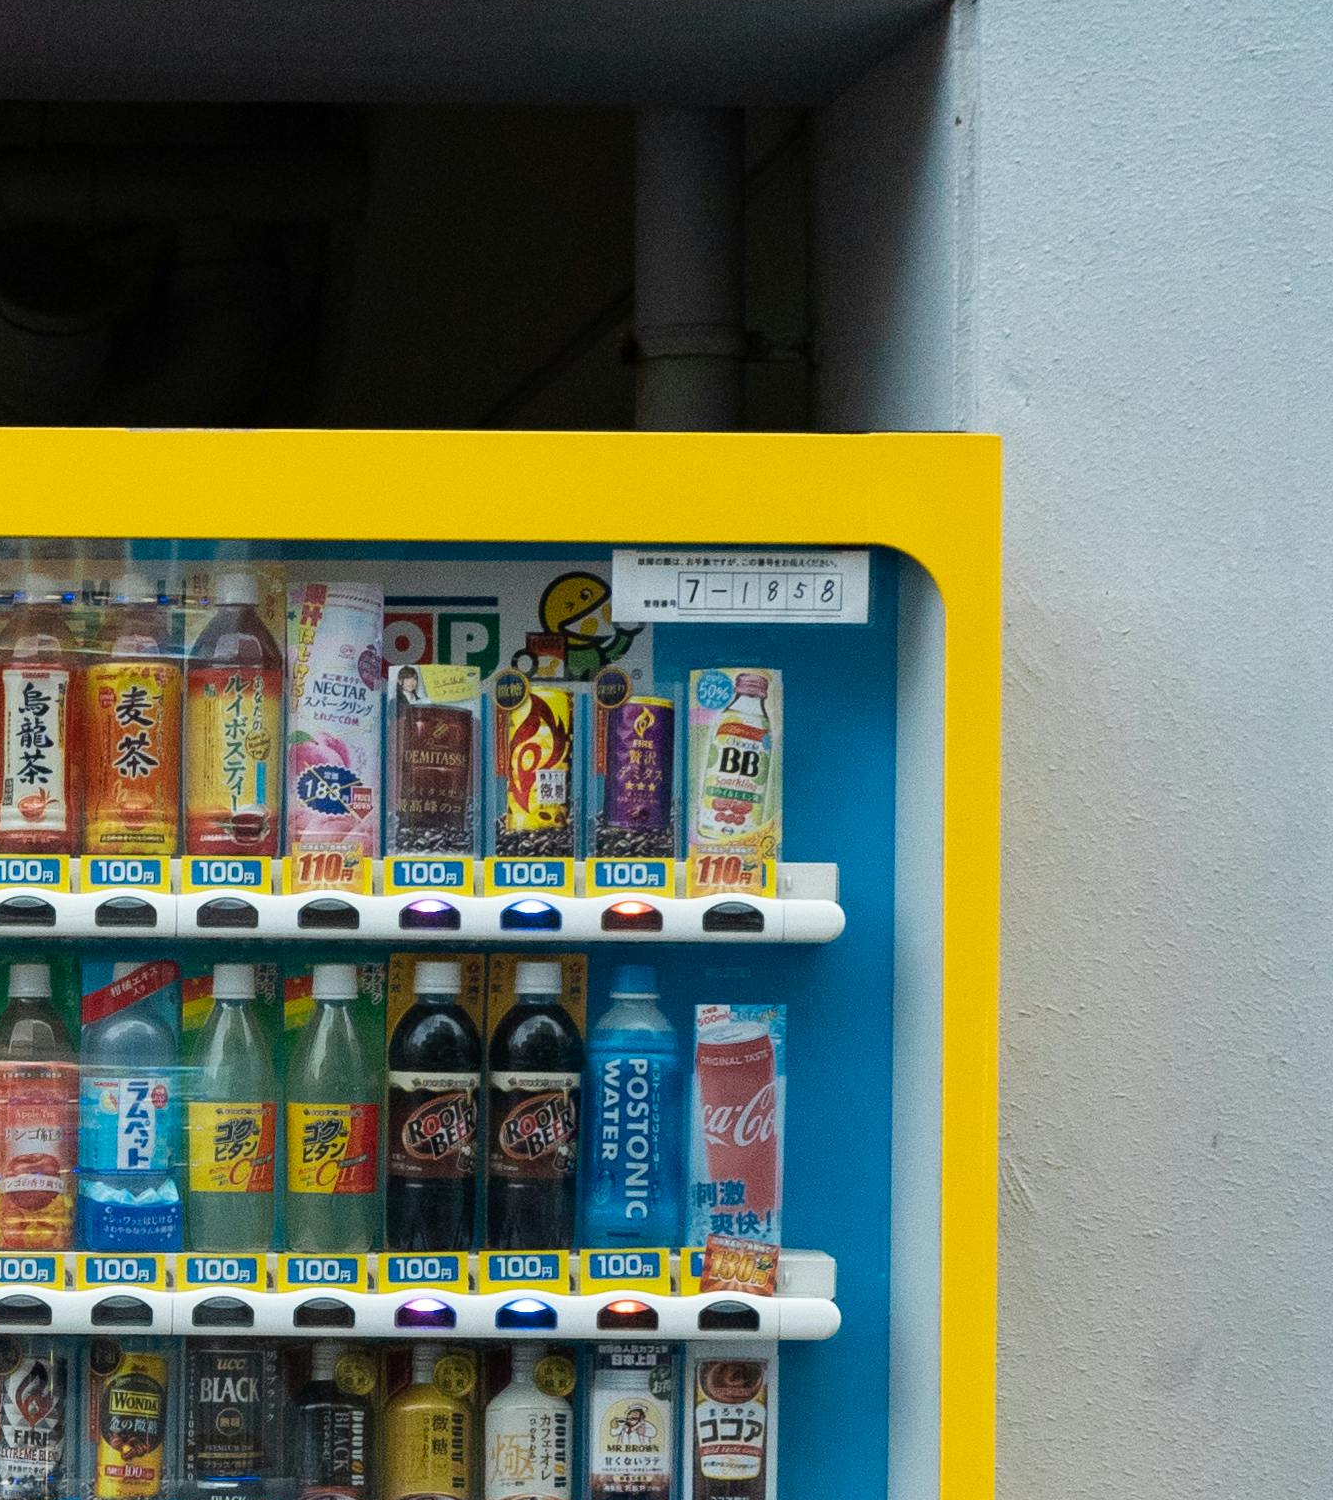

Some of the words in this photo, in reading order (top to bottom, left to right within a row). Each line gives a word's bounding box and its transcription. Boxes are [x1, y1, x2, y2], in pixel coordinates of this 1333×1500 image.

[686, 579, 834, 603] 7-1858
[312, 682, 367, 701] NECTAR
[699, 682, 730, 700] 50%
[305, 696, 373, 716] スパークリング
[16, 682, 54, 785] 烏龍茶
[115, 686, 160, 779] 麦茶
[222, 675, 249, 812] ルイボスティー
[719, 747, 760, 779] BB
[199, 862, 255, 885] 100円
[298, 855, 354, 883] 110円
[401, 863, 457, 886] 100円
[603, 863, 660, 886] 100円
[696, 855, 752, 886] 110円
[406, 1096, 467, 1146] ROOT
[504, 1096, 566, 1146] ROOT
[602, 1058, 618, 1160] WATER
[432, 1112, 476, 1158] BEER
[530, 1111, 577, 1159] BEER
[626, 1058, 649, 1220] POSTONIC
[214, 1141, 258, 1162] ビタン
[195, 1260, 250, 1282] 100円
[217, 1357, 247, 1371] ucc
[113, 1393, 159, 1411] WONDA
[200, 1376, 259, 1403] BLACK
[334, 1412, 349, 1472] BLACK
[699, 1419, 764, 1444] ココア
